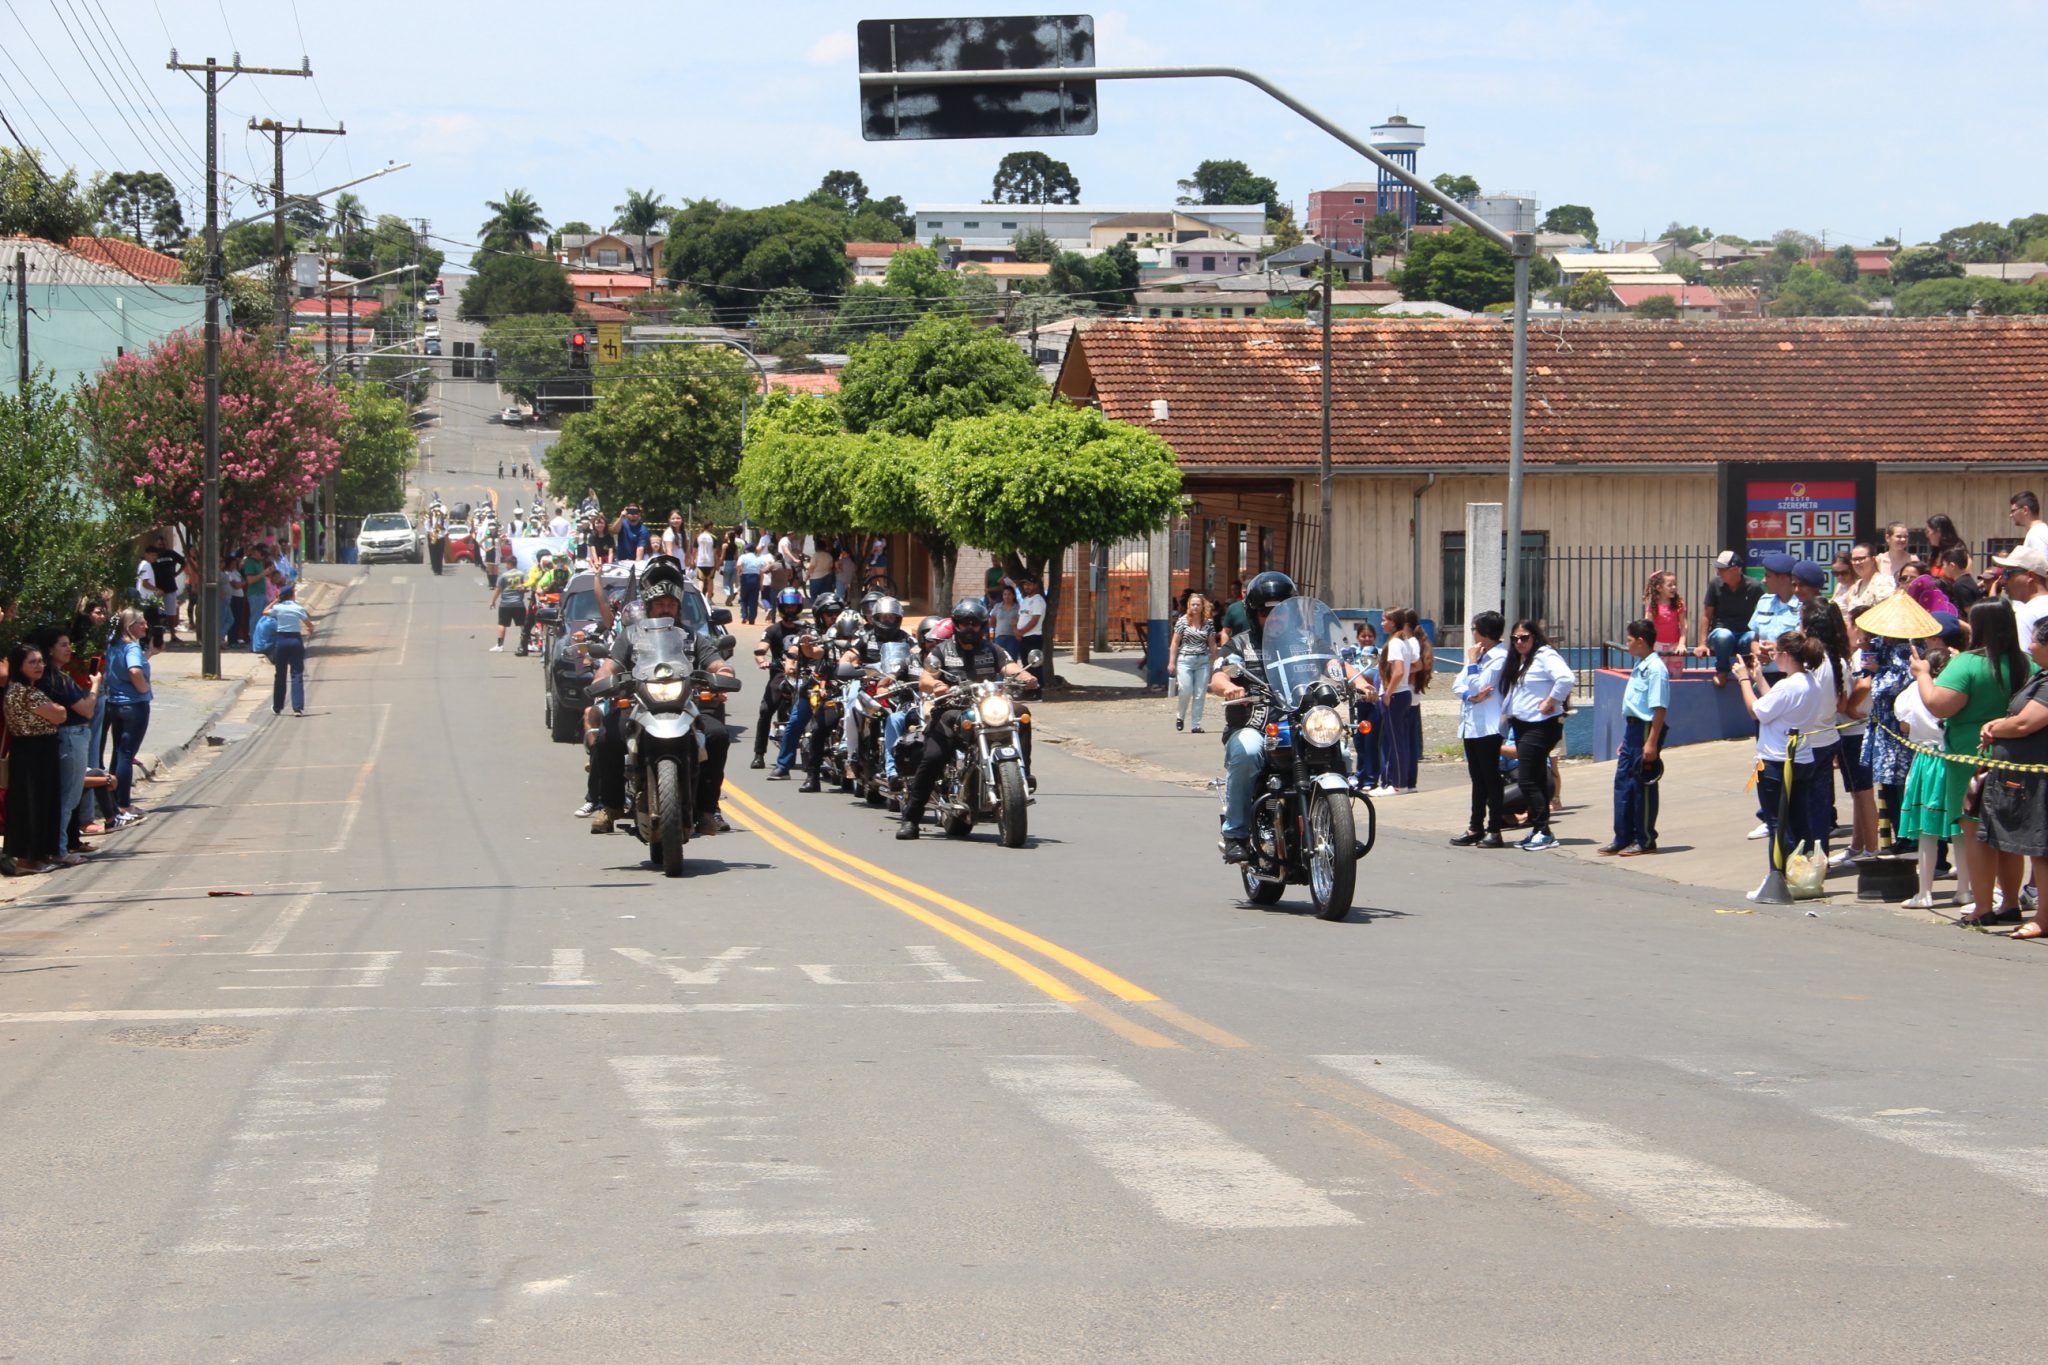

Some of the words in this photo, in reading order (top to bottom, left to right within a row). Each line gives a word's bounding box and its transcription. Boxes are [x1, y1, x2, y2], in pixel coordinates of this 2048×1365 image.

[1778, 501, 1818, 509] SZEREMETA
[1790, 513, 1851, 535] 5,95
[218, 946, 984, 989] PARE
